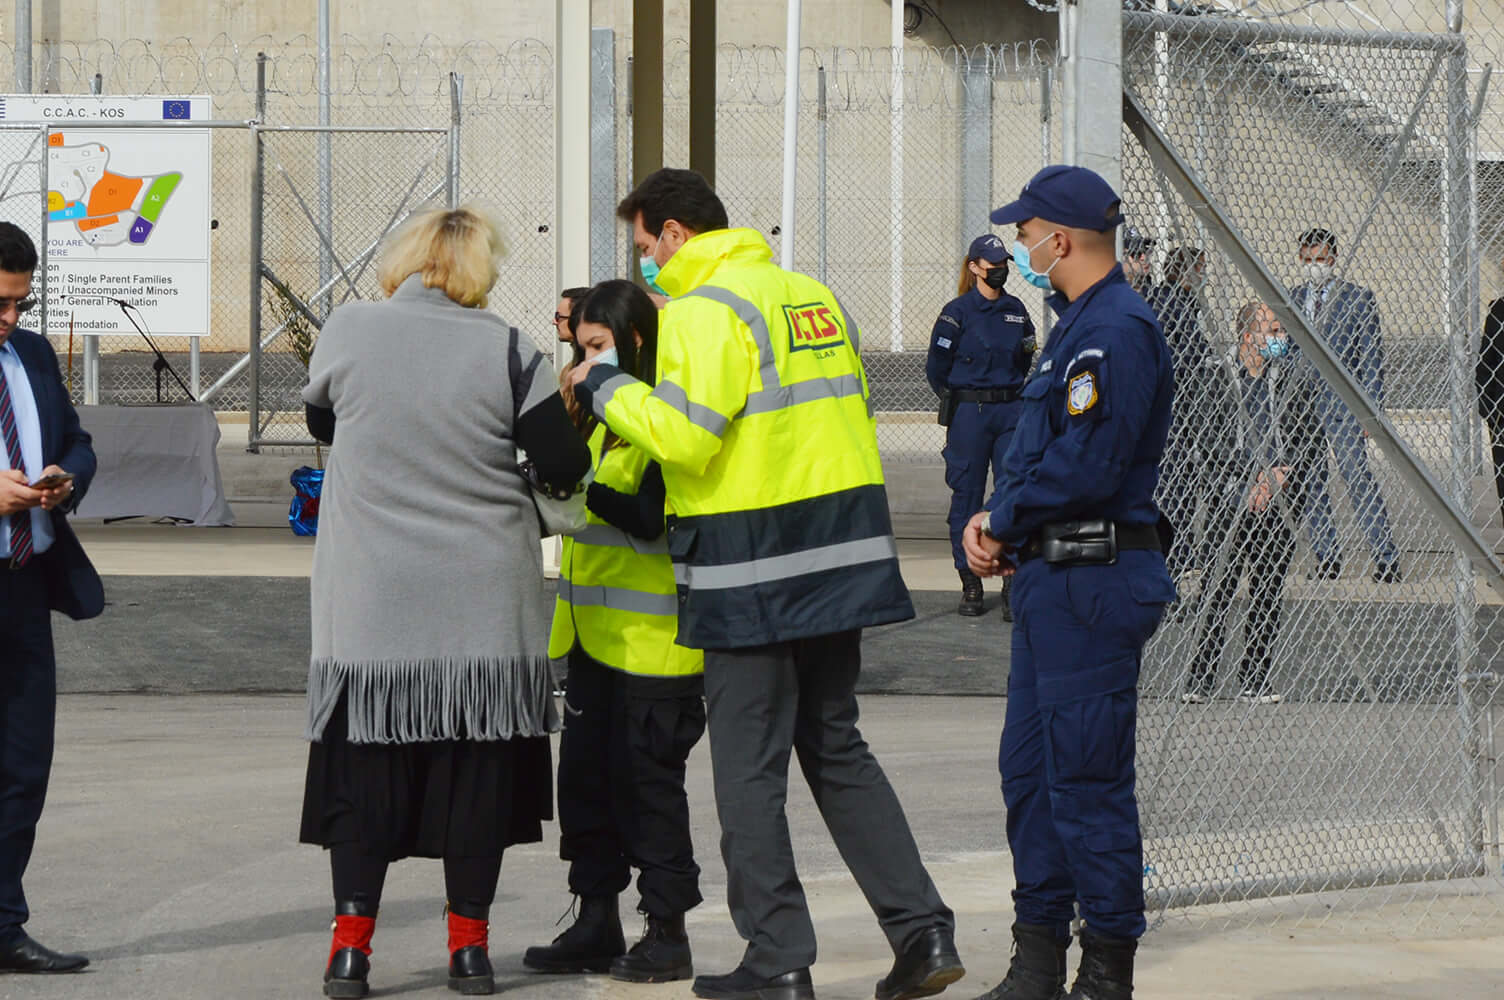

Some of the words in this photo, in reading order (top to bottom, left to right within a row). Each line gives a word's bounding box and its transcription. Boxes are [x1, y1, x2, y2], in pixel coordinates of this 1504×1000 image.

[43, 107, 89, 118] C.C.A.C.
[99, 108, 125, 118] KOS
[67, 239, 83, 247] ARE
[68, 274, 97, 285] Single
[100, 275, 130, 284] Parent
[133, 275, 173, 284] Families
[68, 286, 143, 297] Unaccompanied
[146, 286, 178, 295] Minors
[68, 297, 104, 306] General
[107, 297, 158, 307] Poulation
[44, 319, 118, 329] ccommodation
